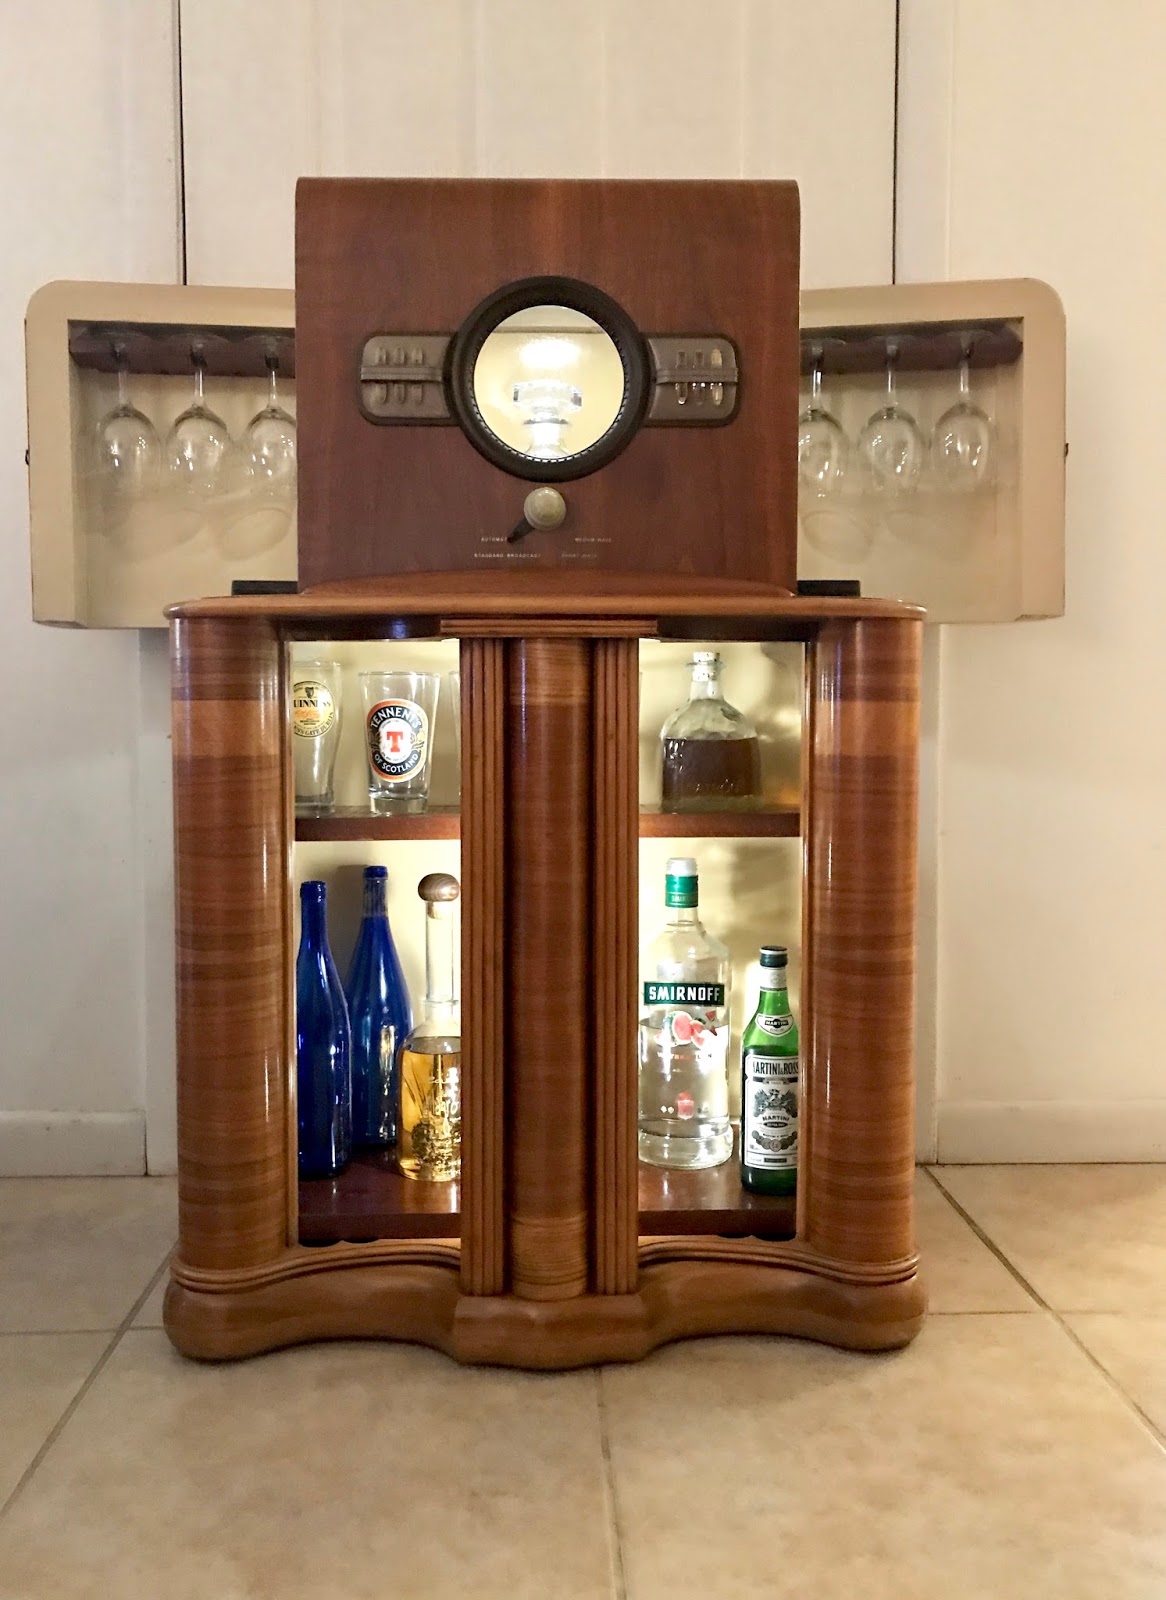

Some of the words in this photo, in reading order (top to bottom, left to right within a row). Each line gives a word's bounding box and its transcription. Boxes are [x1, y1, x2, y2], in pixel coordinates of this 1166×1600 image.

[386, 731, 403, 752] T
[374, 753, 383, 764] OF
[381, 753, 419, 773] SCOTLAND
[649, 986, 720, 1001] SMIRNOFF
